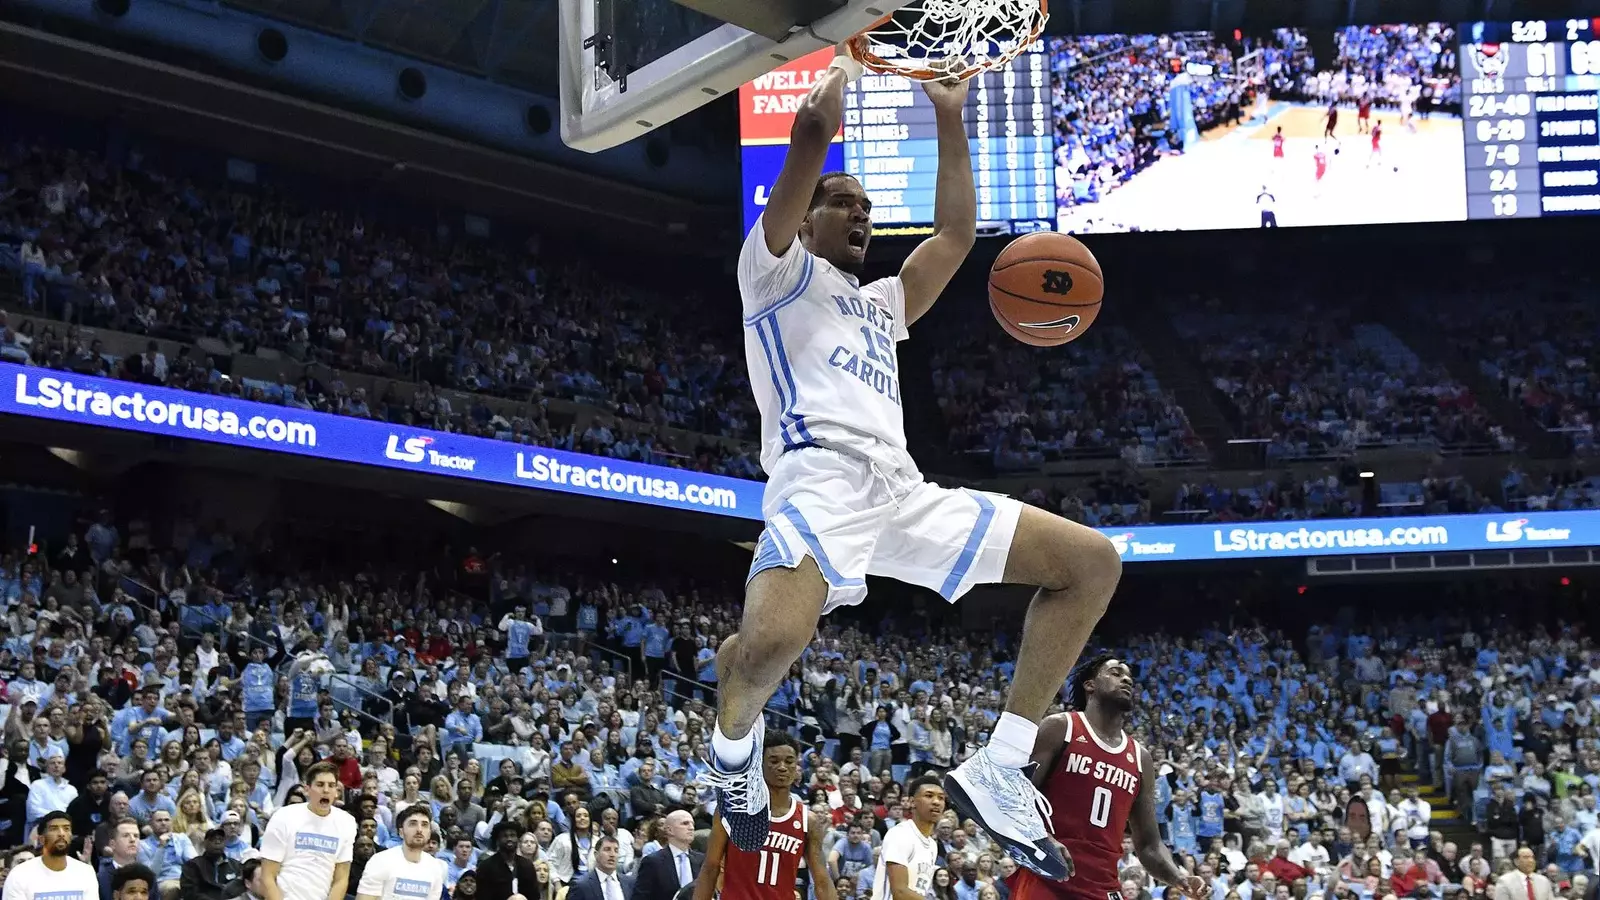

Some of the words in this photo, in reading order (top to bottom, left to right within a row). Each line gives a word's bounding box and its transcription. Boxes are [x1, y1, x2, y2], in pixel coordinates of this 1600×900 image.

[1004, 88, 1014, 103] 7
[1006, 104, 1014, 120] 1
[1005, 121, 1016, 136] 3
[1033, 120, 1044, 136] 3
[1009, 169, 1016, 185] 1
[1490, 169, 1517, 191] 24
[1009, 186, 1017, 202] 1
[1010, 203, 1017, 219] 1
[860, 325, 896, 373] 15
[16, 374, 316, 446] LStractorusa.com
[386, 434, 426, 463] LS
[428, 450, 475, 471] Tractor
[516, 453, 737, 509] LStractorusa.com
[1214, 526, 1448, 552] LStractorusa.com
[1486, 521, 1522, 542] LS
[1066, 753, 1093, 775] NC
[1094, 761, 1138, 795] STATE
[1090, 786, 1112, 828] 0
[758, 850, 780, 886] 11
